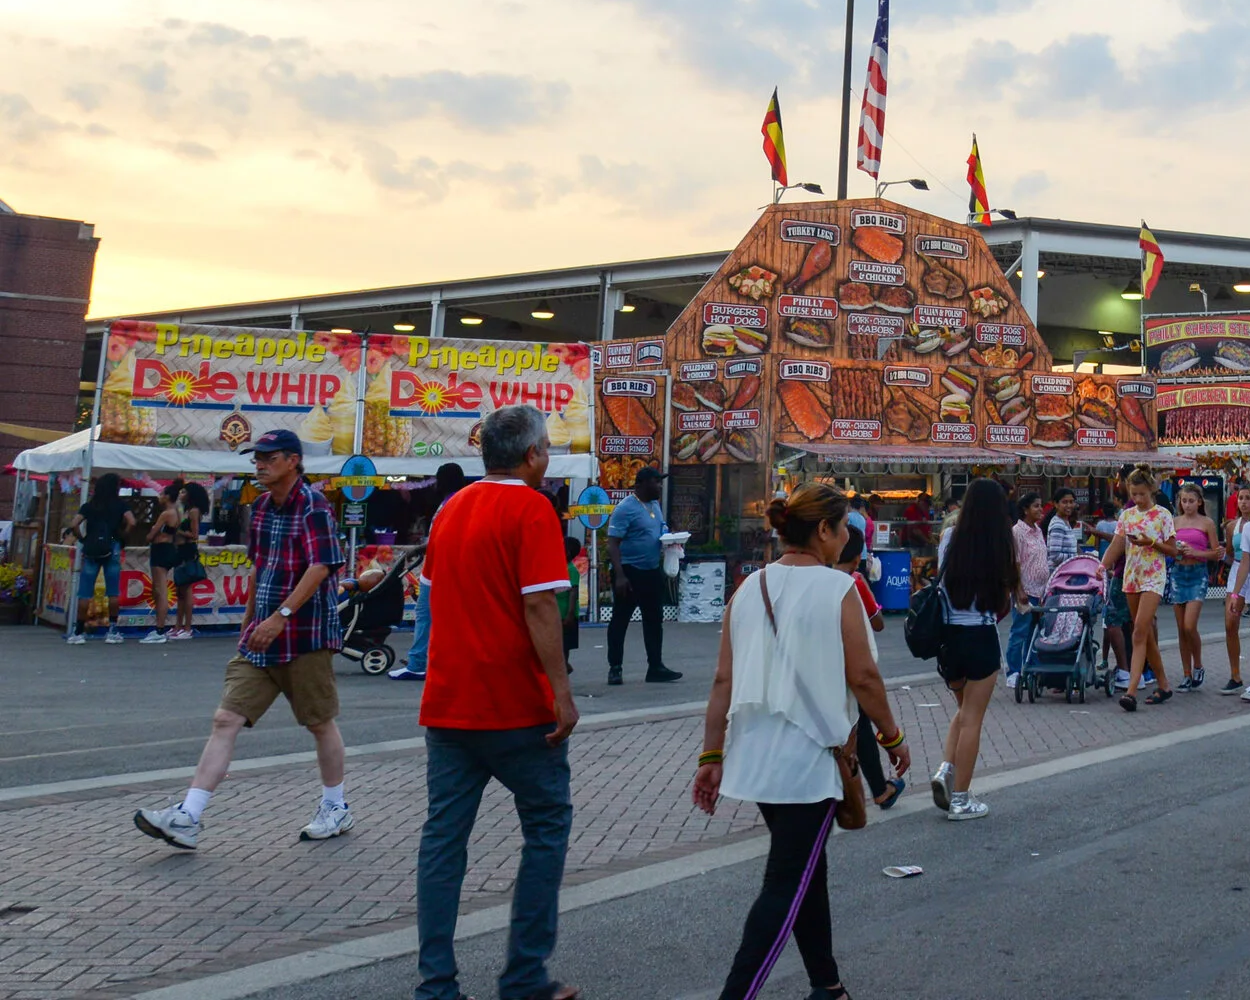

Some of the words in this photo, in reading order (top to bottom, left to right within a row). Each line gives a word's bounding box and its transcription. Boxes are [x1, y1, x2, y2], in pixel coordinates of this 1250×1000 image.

[859, 215, 877, 225] BBQ
[879, 216, 899, 229] RIBS
[787, 227, 815, 238] TURKEY
[816, 229, 834, 241] LEGS
[853, 263, 881, 273] PULLED
[882, 265, 902, 275] PORK
[858, 273, 867, 281] &
[867, 273, 896, 283] CHICKEN
[792, 298, 825, 308] PHILLY
[712, 305, 759, 316] BURGERS
[783, 306, 810, 316] CHEESE
[812, 307, 833, 317] STEAK
[919, 308, 938, 316] ITALIAN
[945, 310, 963, 318] POLISH
[710, 315, 731, 323] HOT
[734, 316, 761, 326] DOGS
[851, 315, 869, 324] PORK
[873, 317, 901, 327] CHICKEN
[919, 315, 961, 326] SAUSAGE
[857, 325, 895, 336] KABOBS
[980, 325, 1000, 334] CORN
[1002, 327, 1022, 335] DOGS
[1148, 324, 1181, 344] PHILLY
[1185, 322, 1226, 336] CHEESE
[980, 333, 999, 342] FRIES
[1003, 335, 1022, 343] RINGS
[155, 323, 327, 366] Pineapple
[408, 336, 560, 376] Pineapple
[608, 354, 631, 365] SAUSAGE
[684, 365, 700, 373] PULLED
[787, 365, 804, 374] BBQ
[806, 365, 824, 375] RIBS
[132, 359, 238, 404] Dole
[611, 381, 627, 391] BBQ
[629, 382, 648, 391] RIBS
[1034, 377, 1053, 385] PULLED
[1055, 378, 1071, 386] PORK
[246, 371, 341, 406] WHIP
[390, 371, 483, 413] Dole
[1121, 385, 1139, 394] TURKEY
[490, 381, 574, 411] WHIP
[1157, 391, 1177, 408] ORK
[1183, 388, 1228, 404] CHICKEN
[732, 412, 750, 420] PHILLY
[683, 420, 711, 428] SAUSAGE
[835, 421, 851, 429] PORK
[853, 422, 878, 430] CHICKEN
[937, 425, 970, 433] BURGERS
[841, 430, 873, 438] KABOBS
[936, 432, 951, 440] HOT
[953, 433, 972, 441] DOGS
[990, 434, 1025, 442] SAUSAGE
[1086, 430, 1107, 438] PHILLY
[629, 438, 648, 446] DOGS
